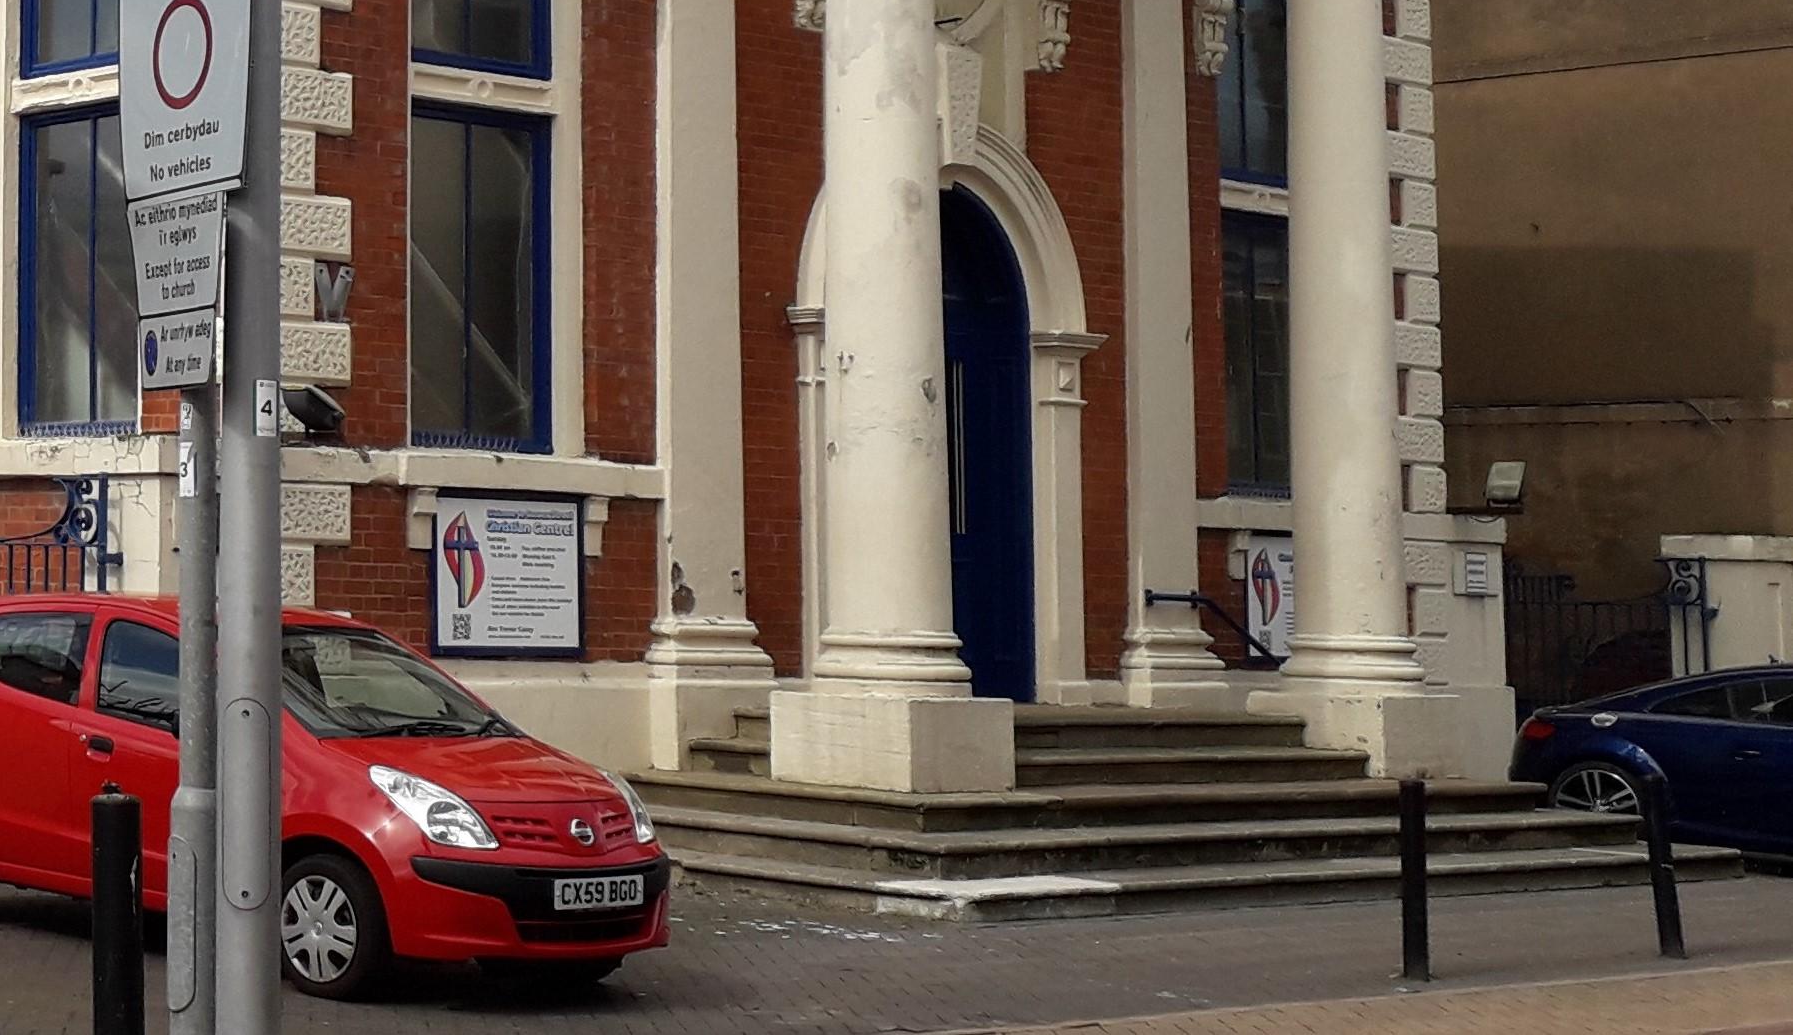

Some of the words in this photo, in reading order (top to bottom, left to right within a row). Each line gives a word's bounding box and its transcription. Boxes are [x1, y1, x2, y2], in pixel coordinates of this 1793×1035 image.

[144, 130, 164, 149] Dim
[167, 118, 219, 143] cerbydau
[150, 164, 164, 182] No
[167, 154, 211, 177] vehicles
[134, 209, 147, 227] Ac
[148, 203, 177, 224] eithrio
[169, 225, 197, 247] eglwys
[145, 260, 172, 279] Except
[173, 257, 184, 275] for
[186, 255, 210, 273] access
[161, 283, 169, 300] to
[171, 278, 196, 299] church
[260, 399, 273, 416] 4
[180, 461, 188, 478] 3
[486, 520, 532, 535] Christian
[561, 881, 605, 905] CX59
